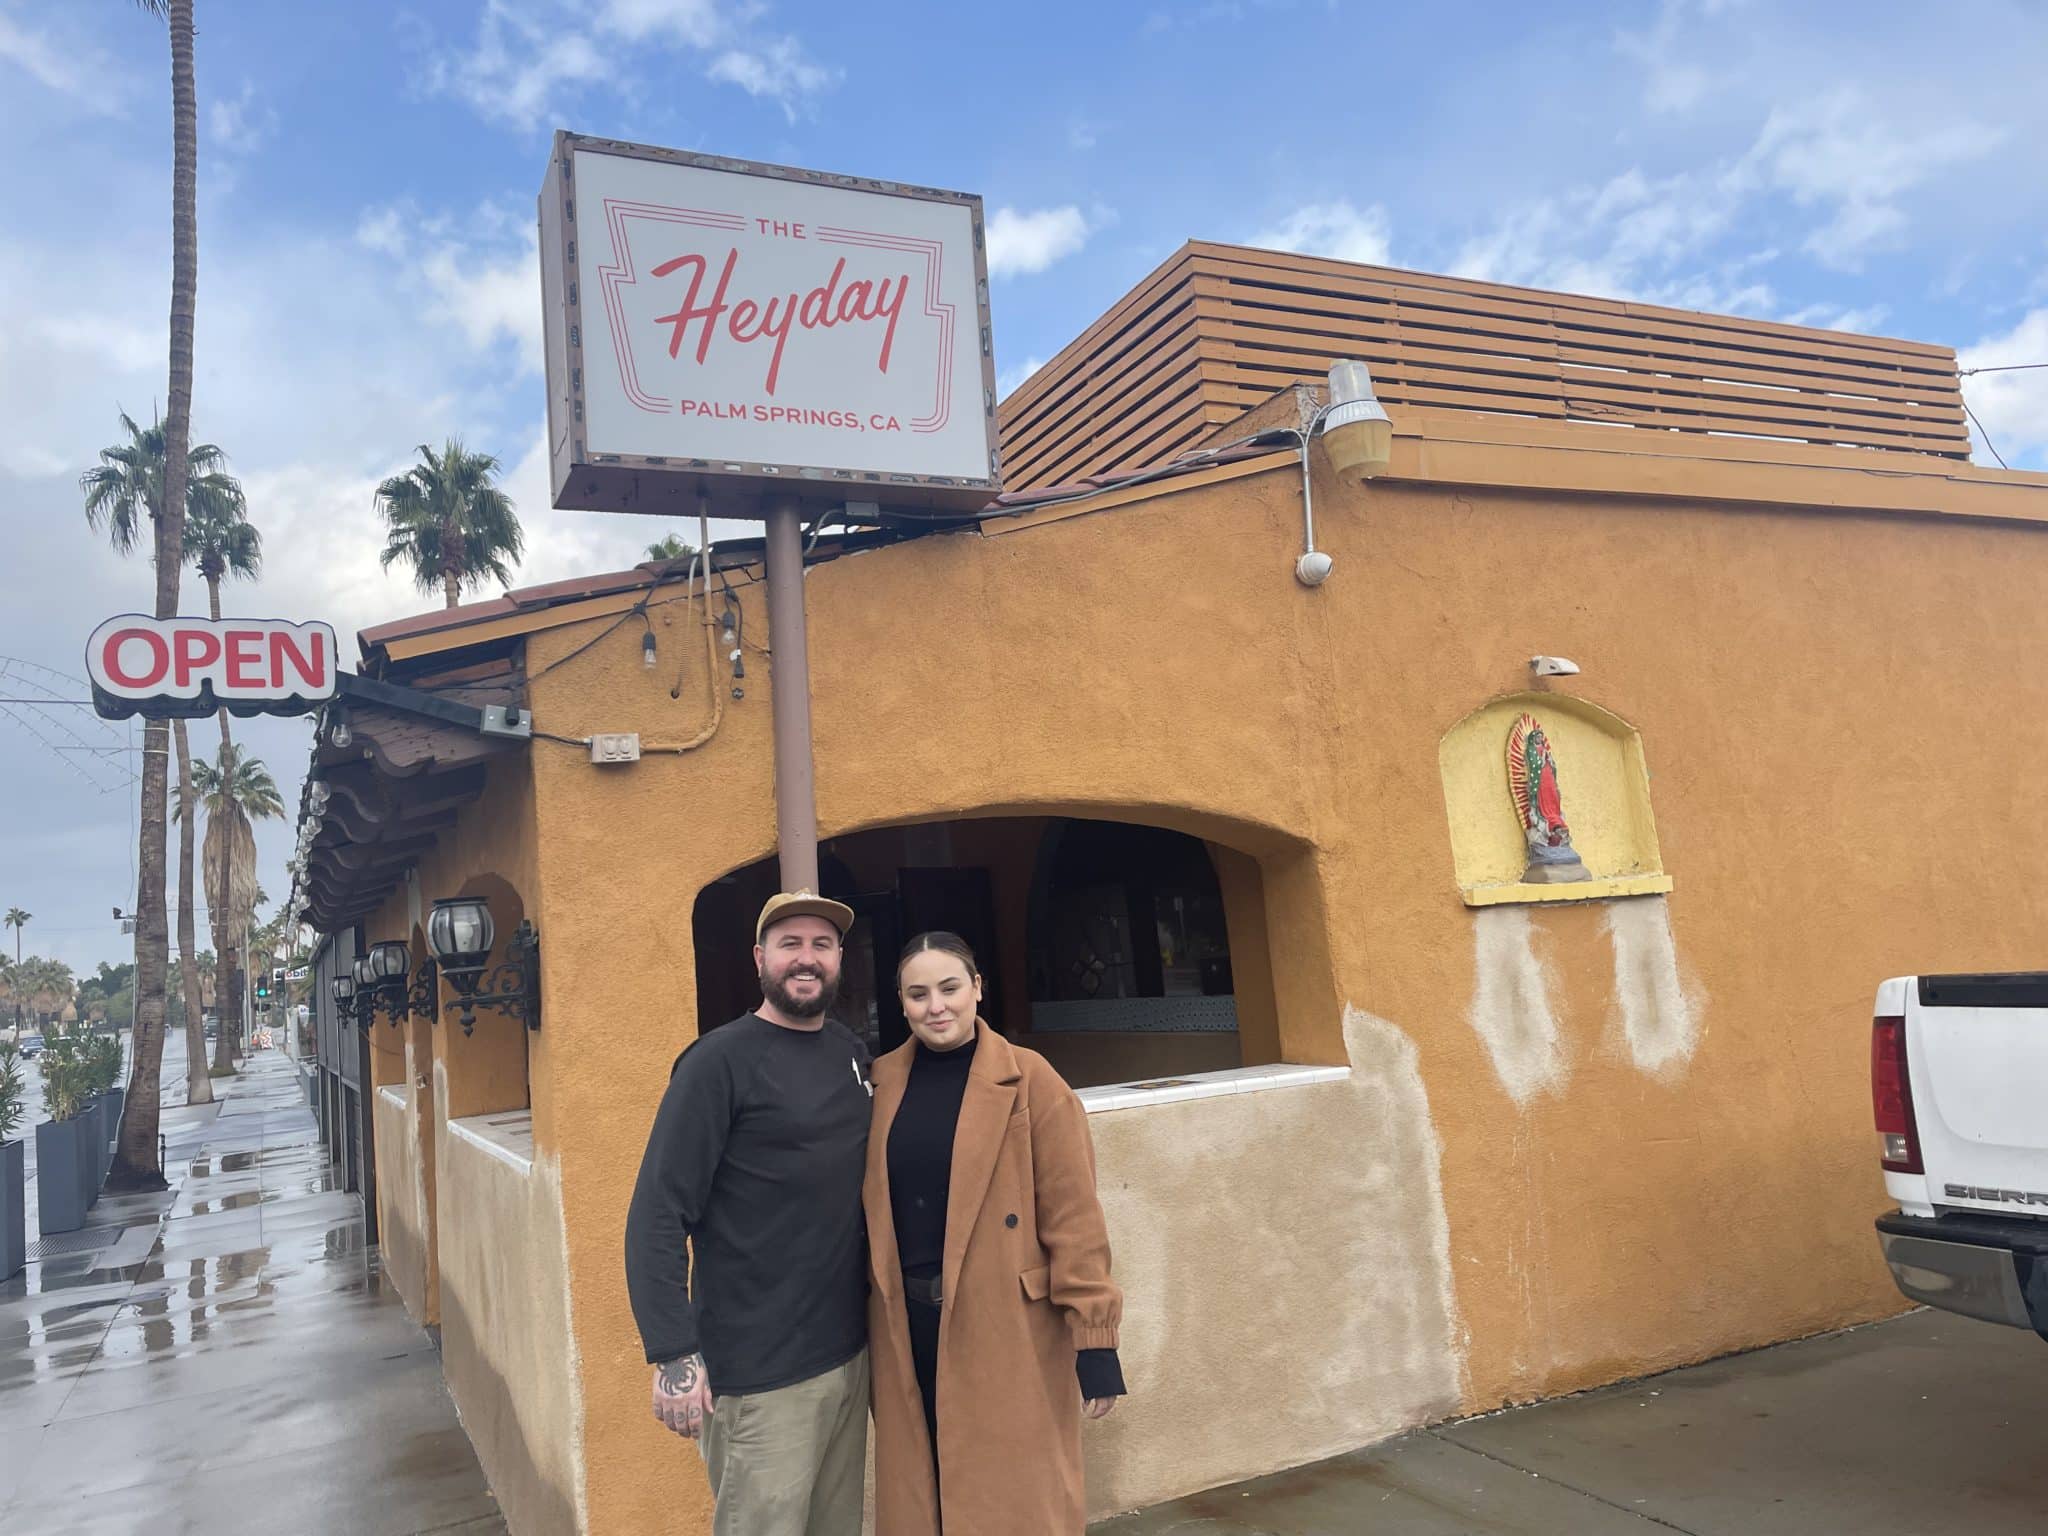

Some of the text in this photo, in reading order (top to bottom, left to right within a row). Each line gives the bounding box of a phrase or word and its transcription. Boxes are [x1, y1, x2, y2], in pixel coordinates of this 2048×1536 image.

[756, 218, 807, 240] THE
[650, 247, 910, 397] Heyday
[681, 399, 901, 433] PALM SPRINGS, CA
[103, 628, 325, 689] OPEN
